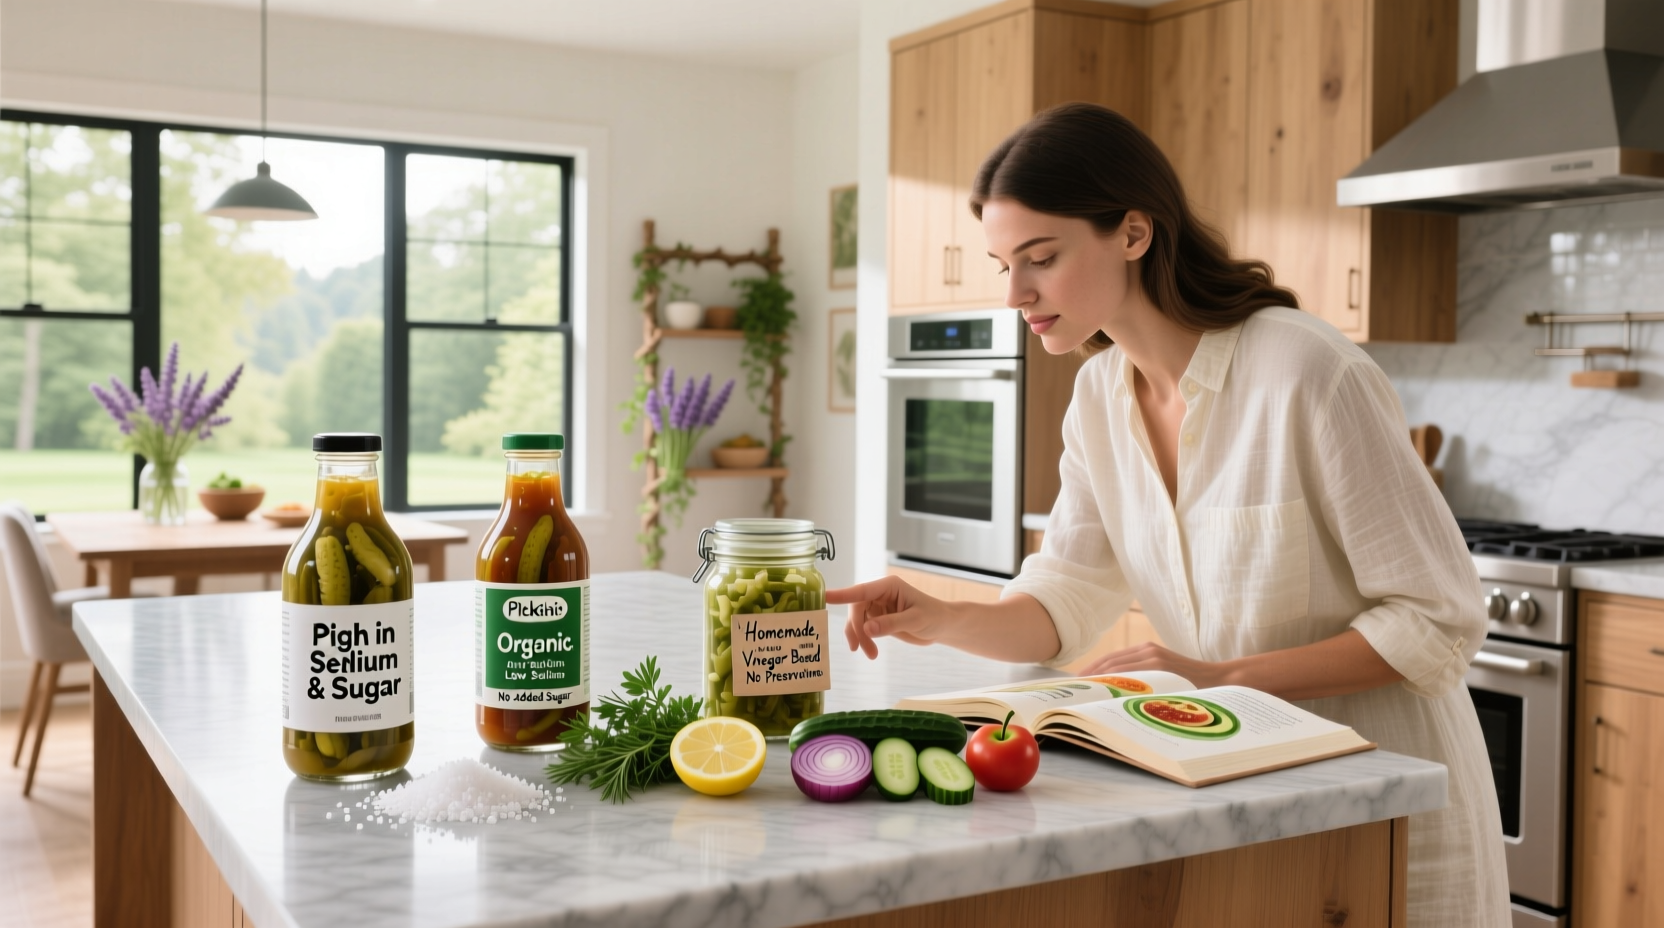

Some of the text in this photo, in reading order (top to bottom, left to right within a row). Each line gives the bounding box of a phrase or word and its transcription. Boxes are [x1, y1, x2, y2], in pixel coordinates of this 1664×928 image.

[313, 621, 395, 652] Pigh in
[497, 632, 573, 659] Organic
[505, 670, 527, 680] Low
[746, 671, 761, 684] No
[307, 676, 402, 704] & Sugar
[498, 692, 511, 702] No
